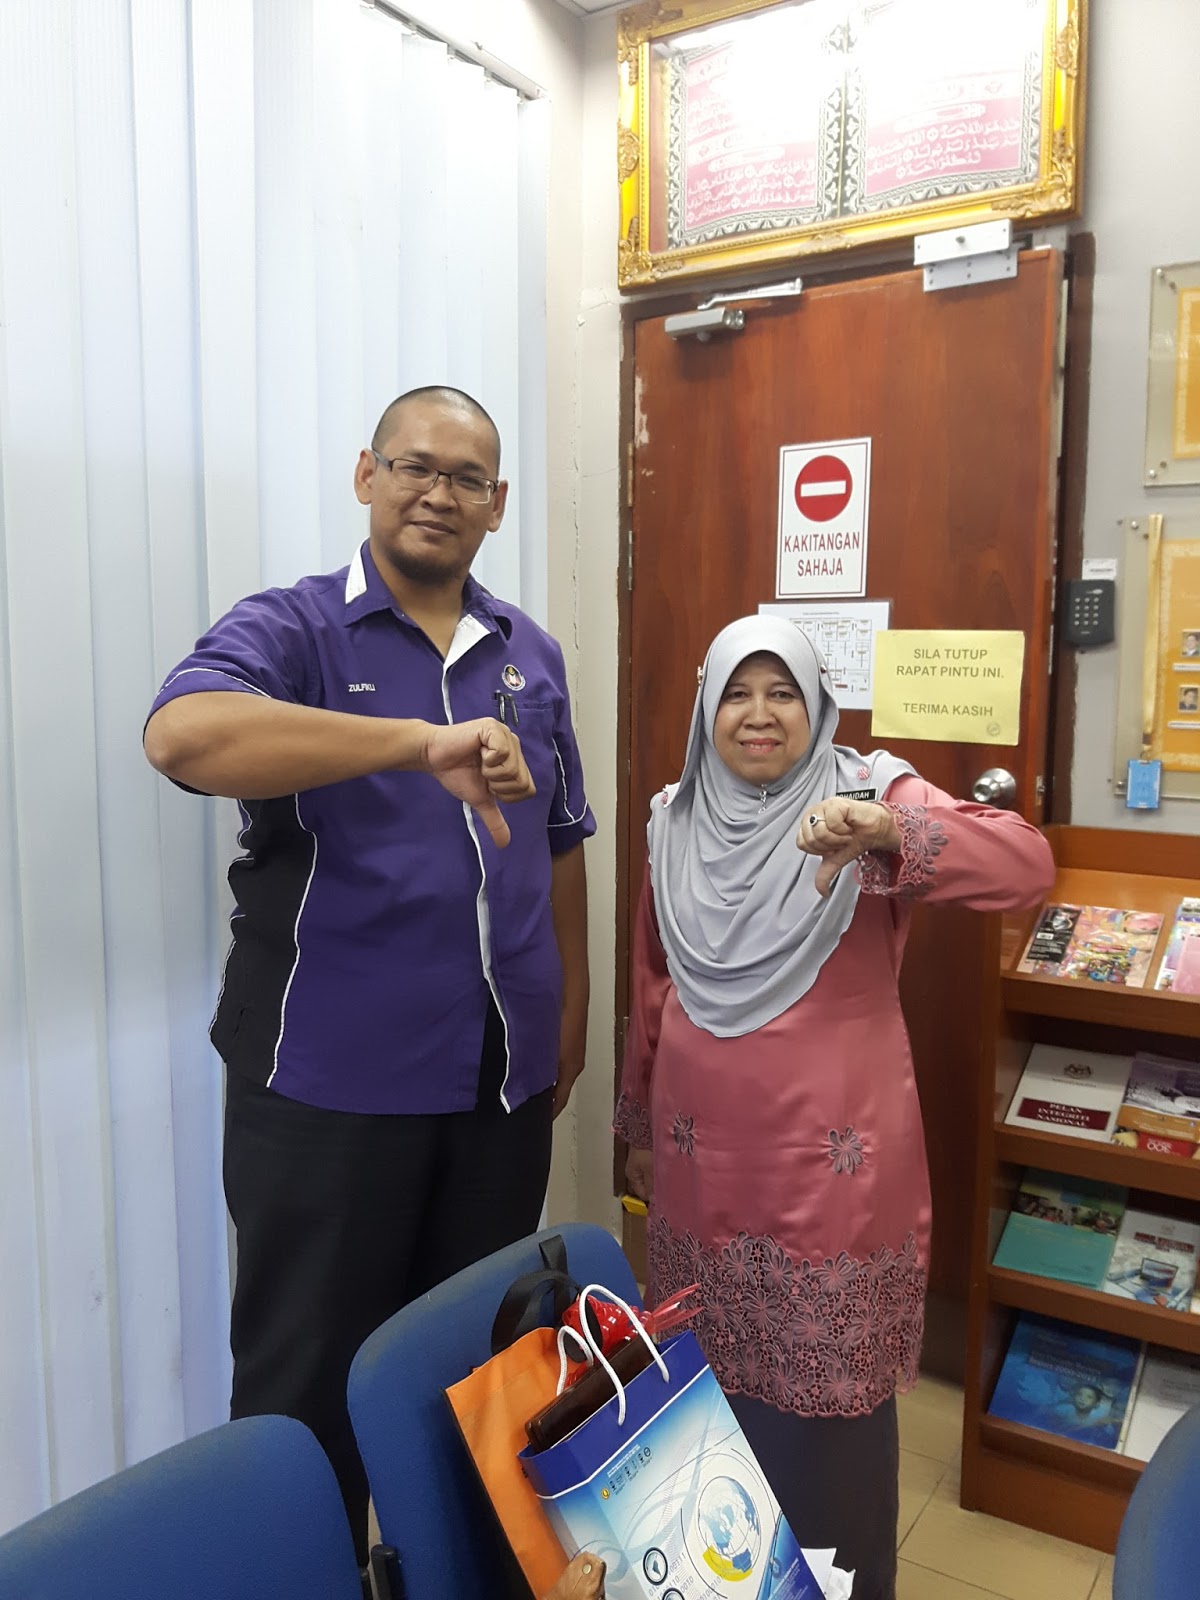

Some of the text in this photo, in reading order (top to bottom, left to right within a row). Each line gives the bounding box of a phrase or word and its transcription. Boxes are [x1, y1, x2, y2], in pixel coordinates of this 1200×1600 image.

[784, 531, 860, 553] KAKITANGAN
[797, 557, 843, 577] SAHAJA
[913, 648, 988, 660] SILA TUTUP
[896, 665, 1005, 679] RAPAT PINTU INI.
[903, 702, 993, 717] TERIMA KASIH
